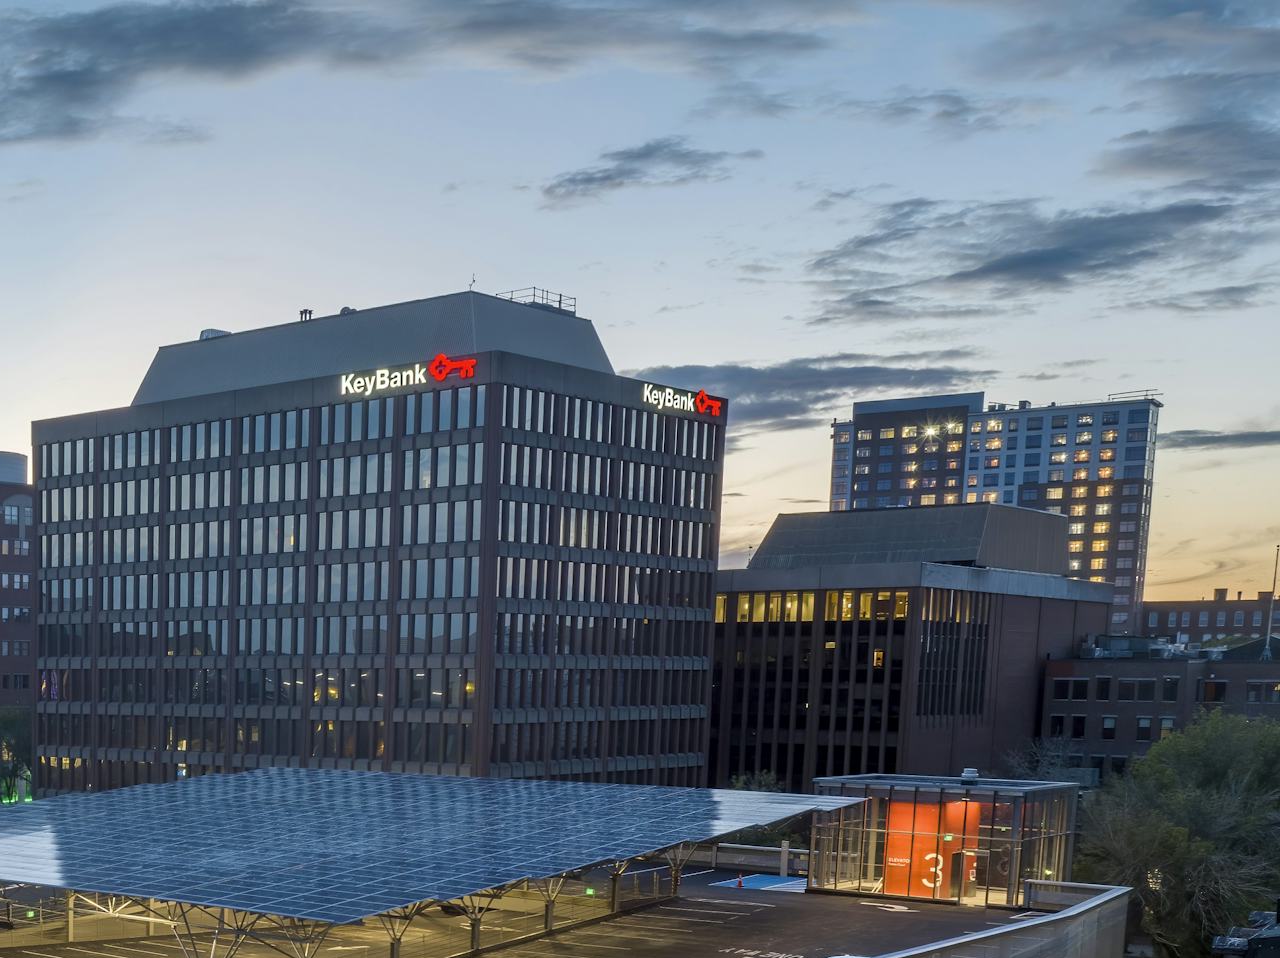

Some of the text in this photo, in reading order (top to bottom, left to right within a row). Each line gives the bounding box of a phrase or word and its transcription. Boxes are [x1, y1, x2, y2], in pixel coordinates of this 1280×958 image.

[341, 364, 426, 395] KeyBank
[643, 384, 695, 412] KeyBank
[921, 852, 944, 888] 3
